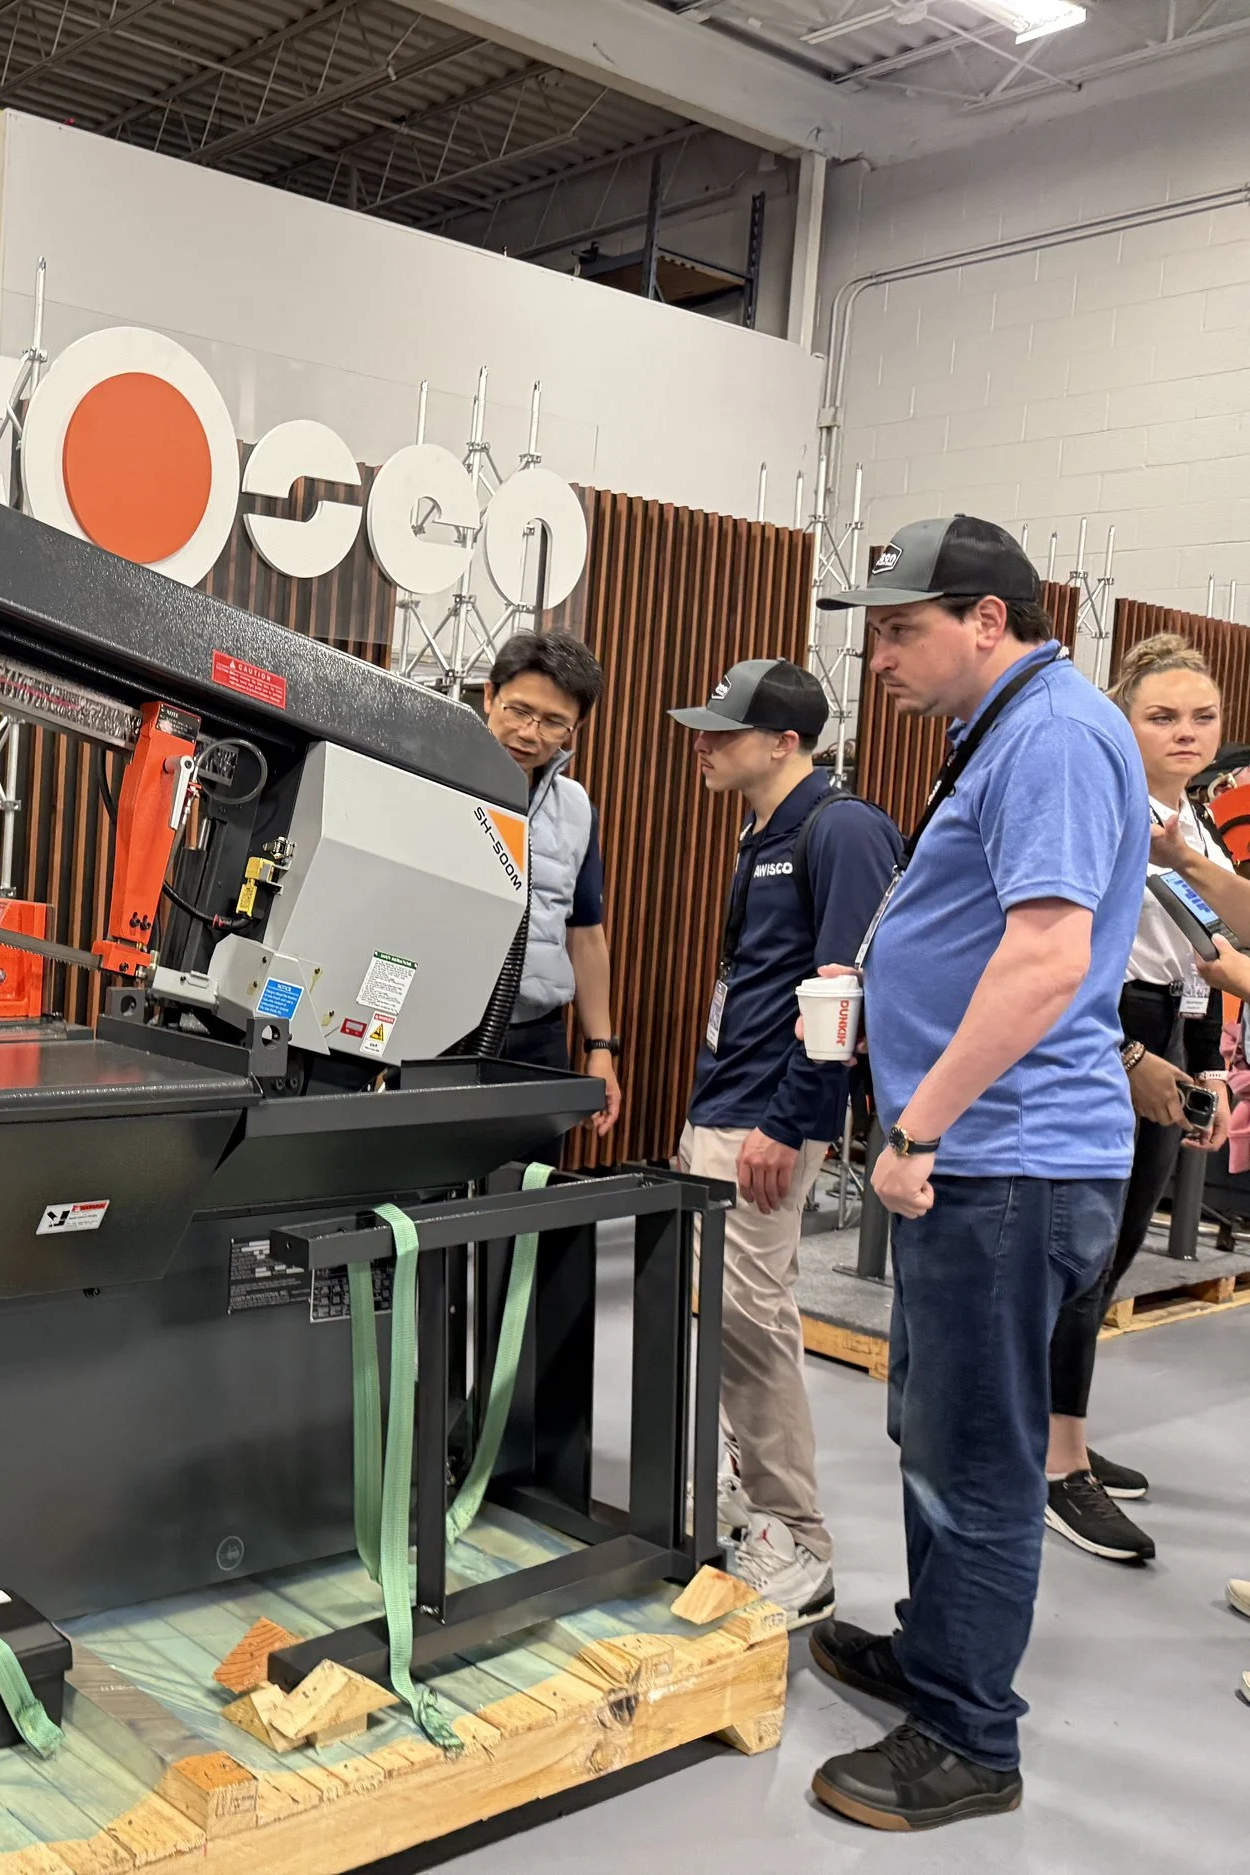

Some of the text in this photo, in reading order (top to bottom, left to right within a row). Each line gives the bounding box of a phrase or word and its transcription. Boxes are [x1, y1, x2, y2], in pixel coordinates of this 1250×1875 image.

[238, 663, 271, 681] CAUTION
[473, 806, 522, 891] SH-500M
[753, 861, 793, 878] AWISCO
